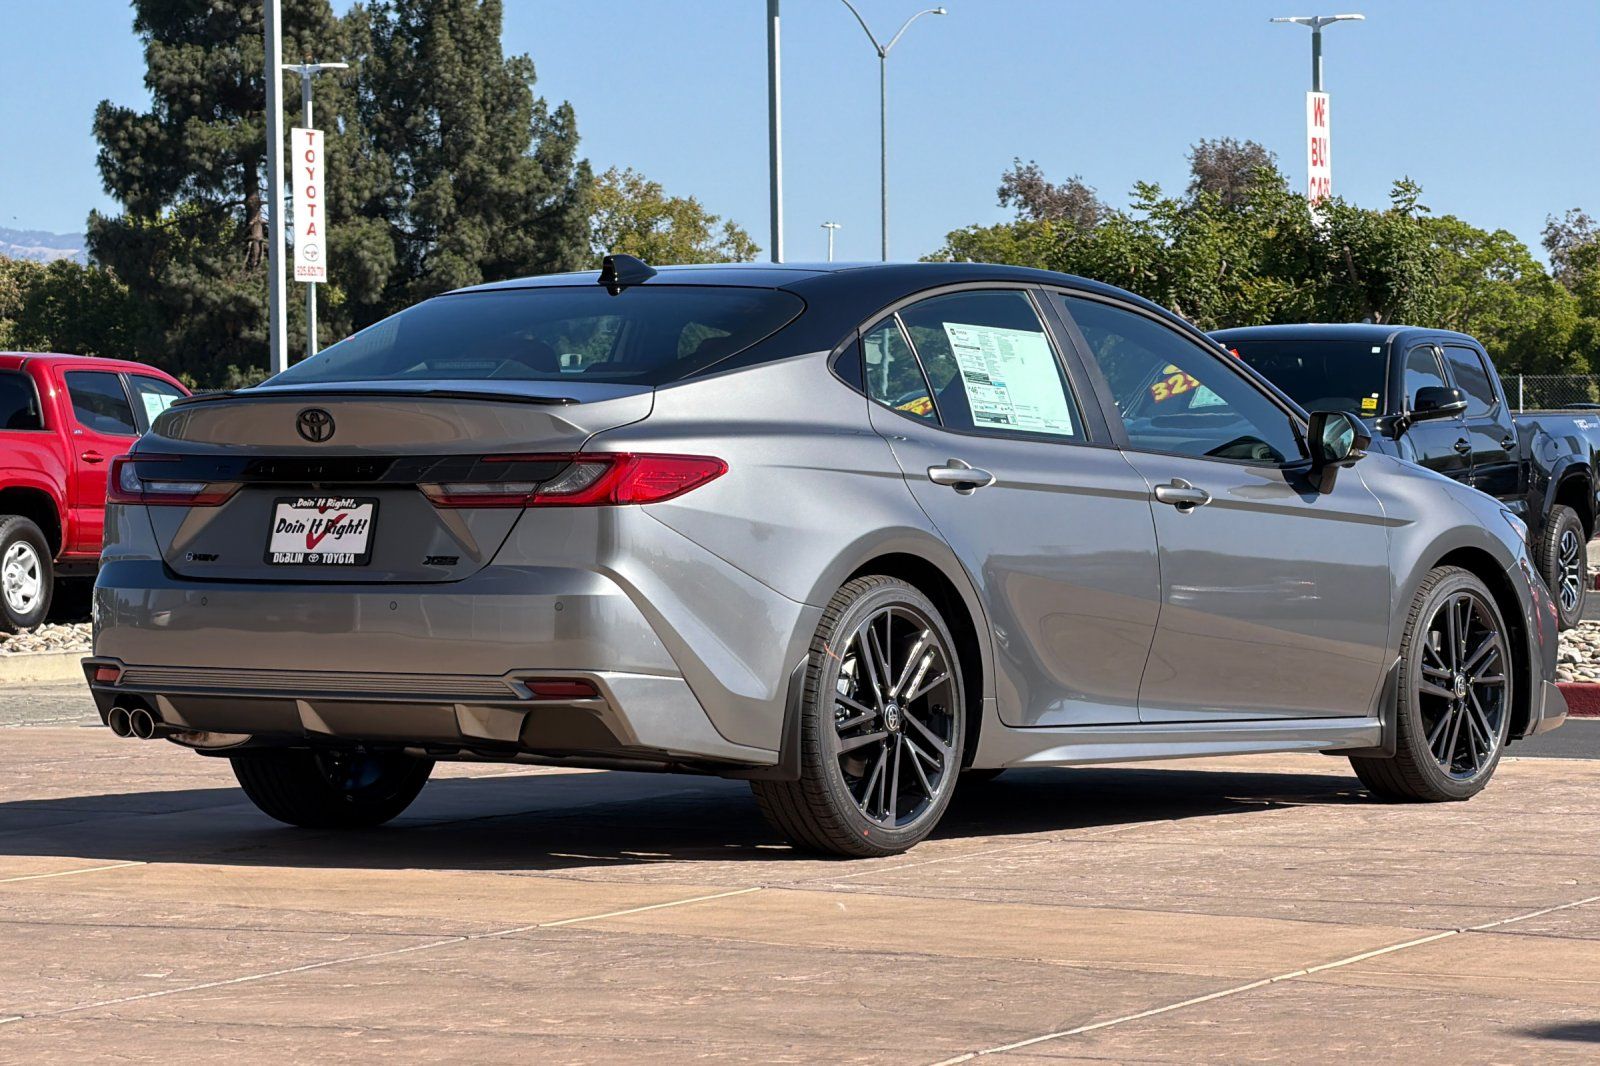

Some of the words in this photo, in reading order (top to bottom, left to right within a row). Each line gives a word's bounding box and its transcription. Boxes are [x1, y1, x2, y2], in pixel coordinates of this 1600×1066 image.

[305, 132, 317, 236] TOYOTA
[326, 498, 354, 510] Right!
[276, 518, 309, 534] Doin'
[309, 519, 323, 534] It
[324, 518, 368, 540] Right!
[322, 553, 355, 563] TOYOTA
